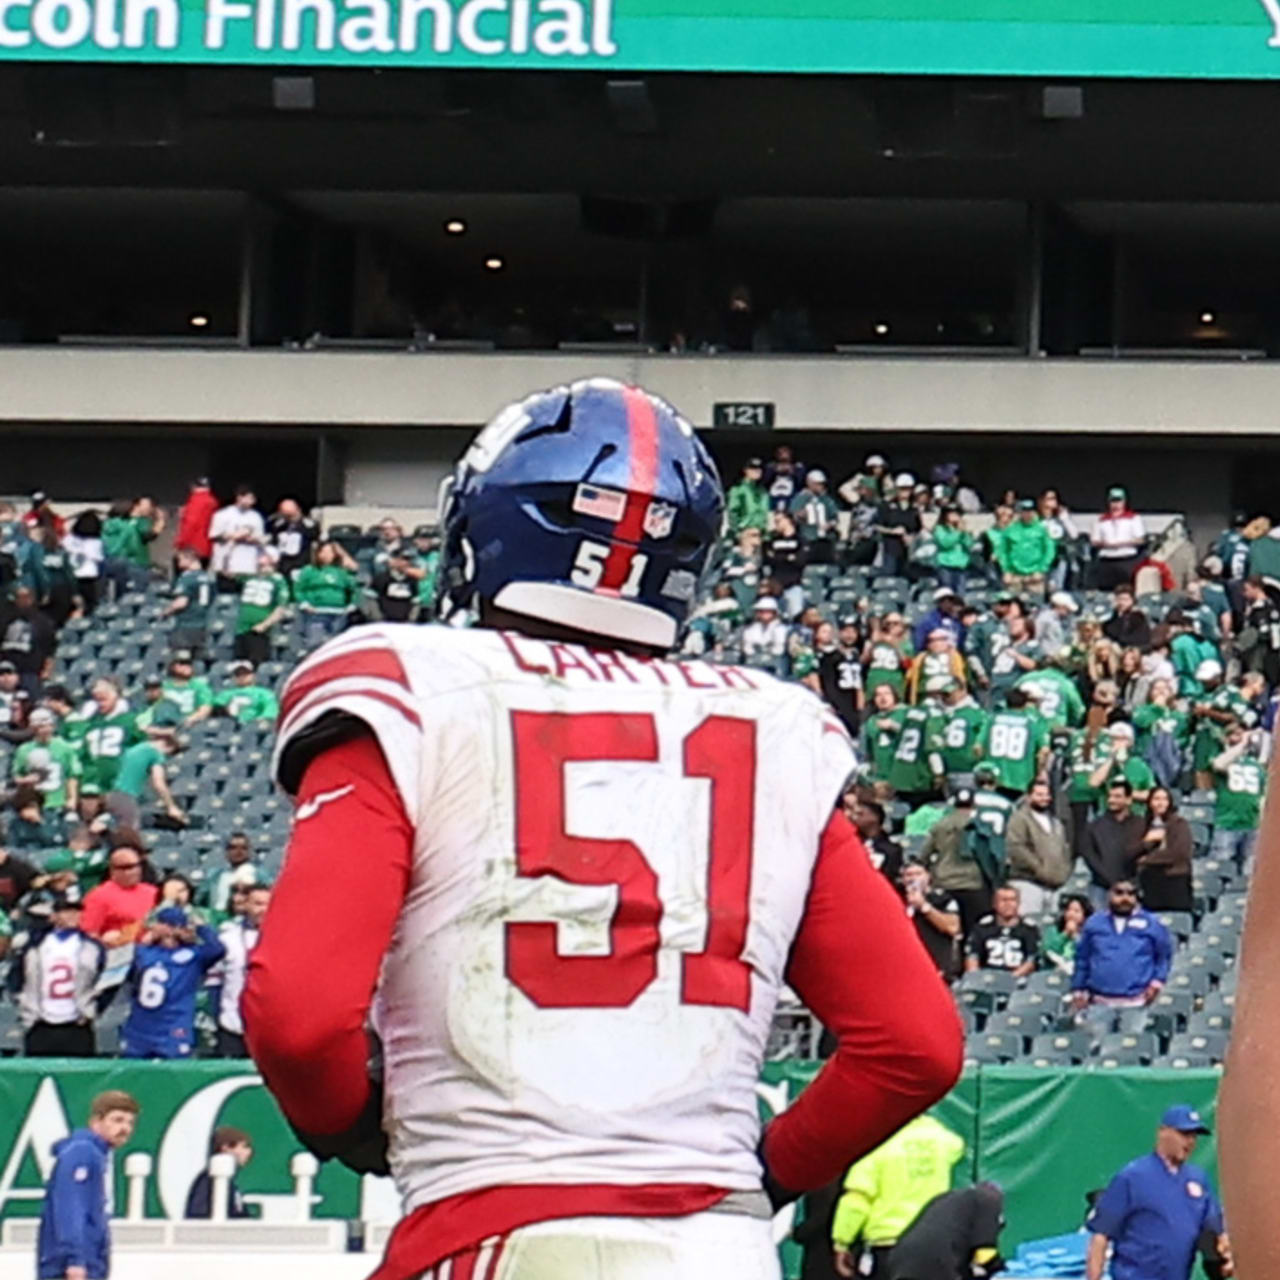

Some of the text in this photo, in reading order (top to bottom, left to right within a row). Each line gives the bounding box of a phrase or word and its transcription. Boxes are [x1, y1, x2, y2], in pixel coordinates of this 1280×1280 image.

[723, 405, 766, 426] 121
[570, 540, 648, 598] 51
[85, 725, 124, 757] 12
[990, 723, 1029, 761] 88
[508, 710, 757, 1014] 51
[987, 937, 1023, 968] 26
[49, 964, 74, 1000] 2
[138, 964, 169, 1009] 6
